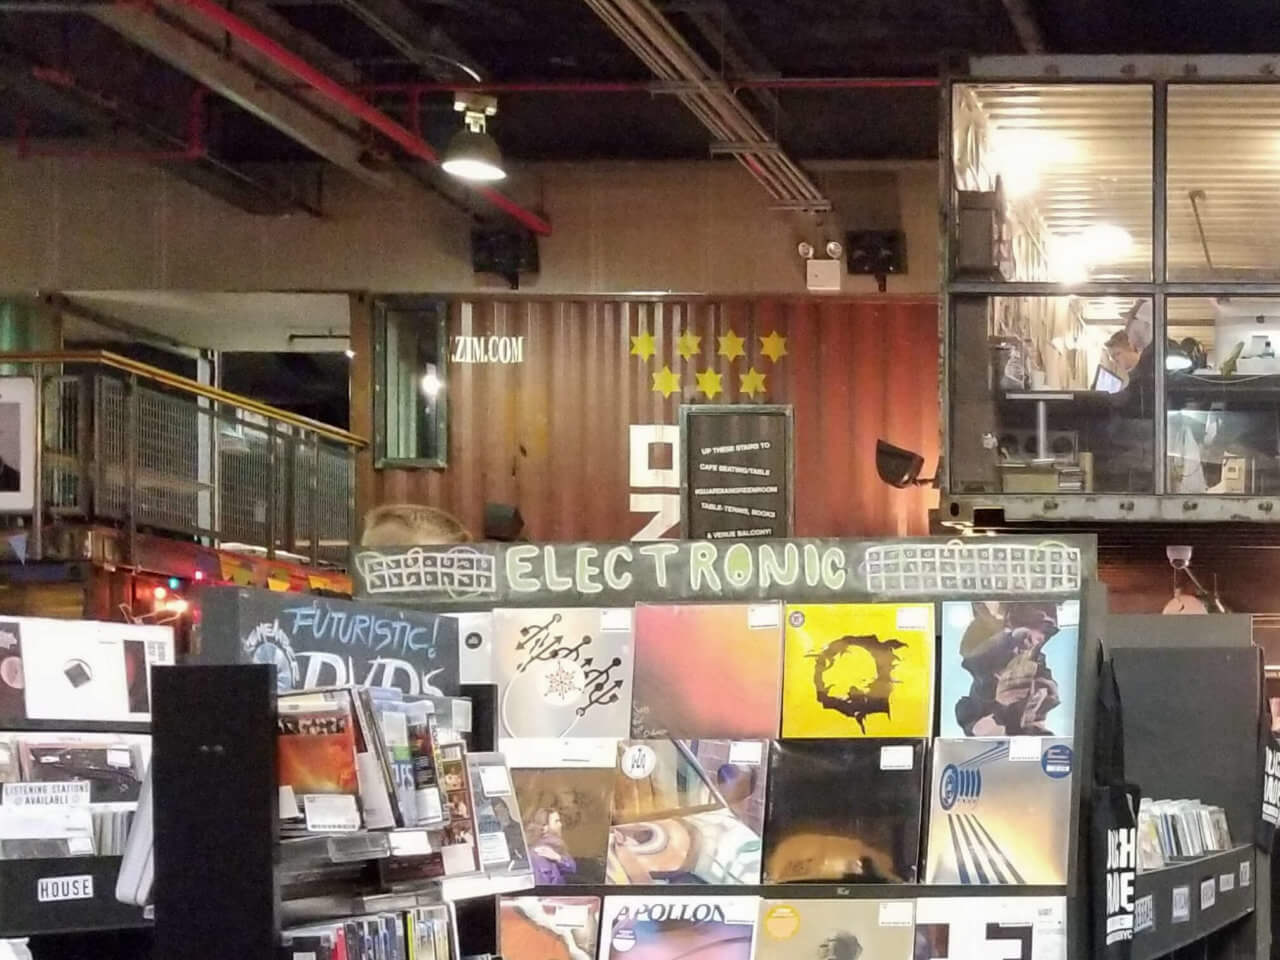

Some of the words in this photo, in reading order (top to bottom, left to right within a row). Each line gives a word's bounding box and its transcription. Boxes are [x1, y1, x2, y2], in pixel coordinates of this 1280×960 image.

[449, 335, 525, 364] .ZIM.COM
[506, 543, 846, 593] ELECTRONIC
[40, 880, 90, 899] HOUSE
